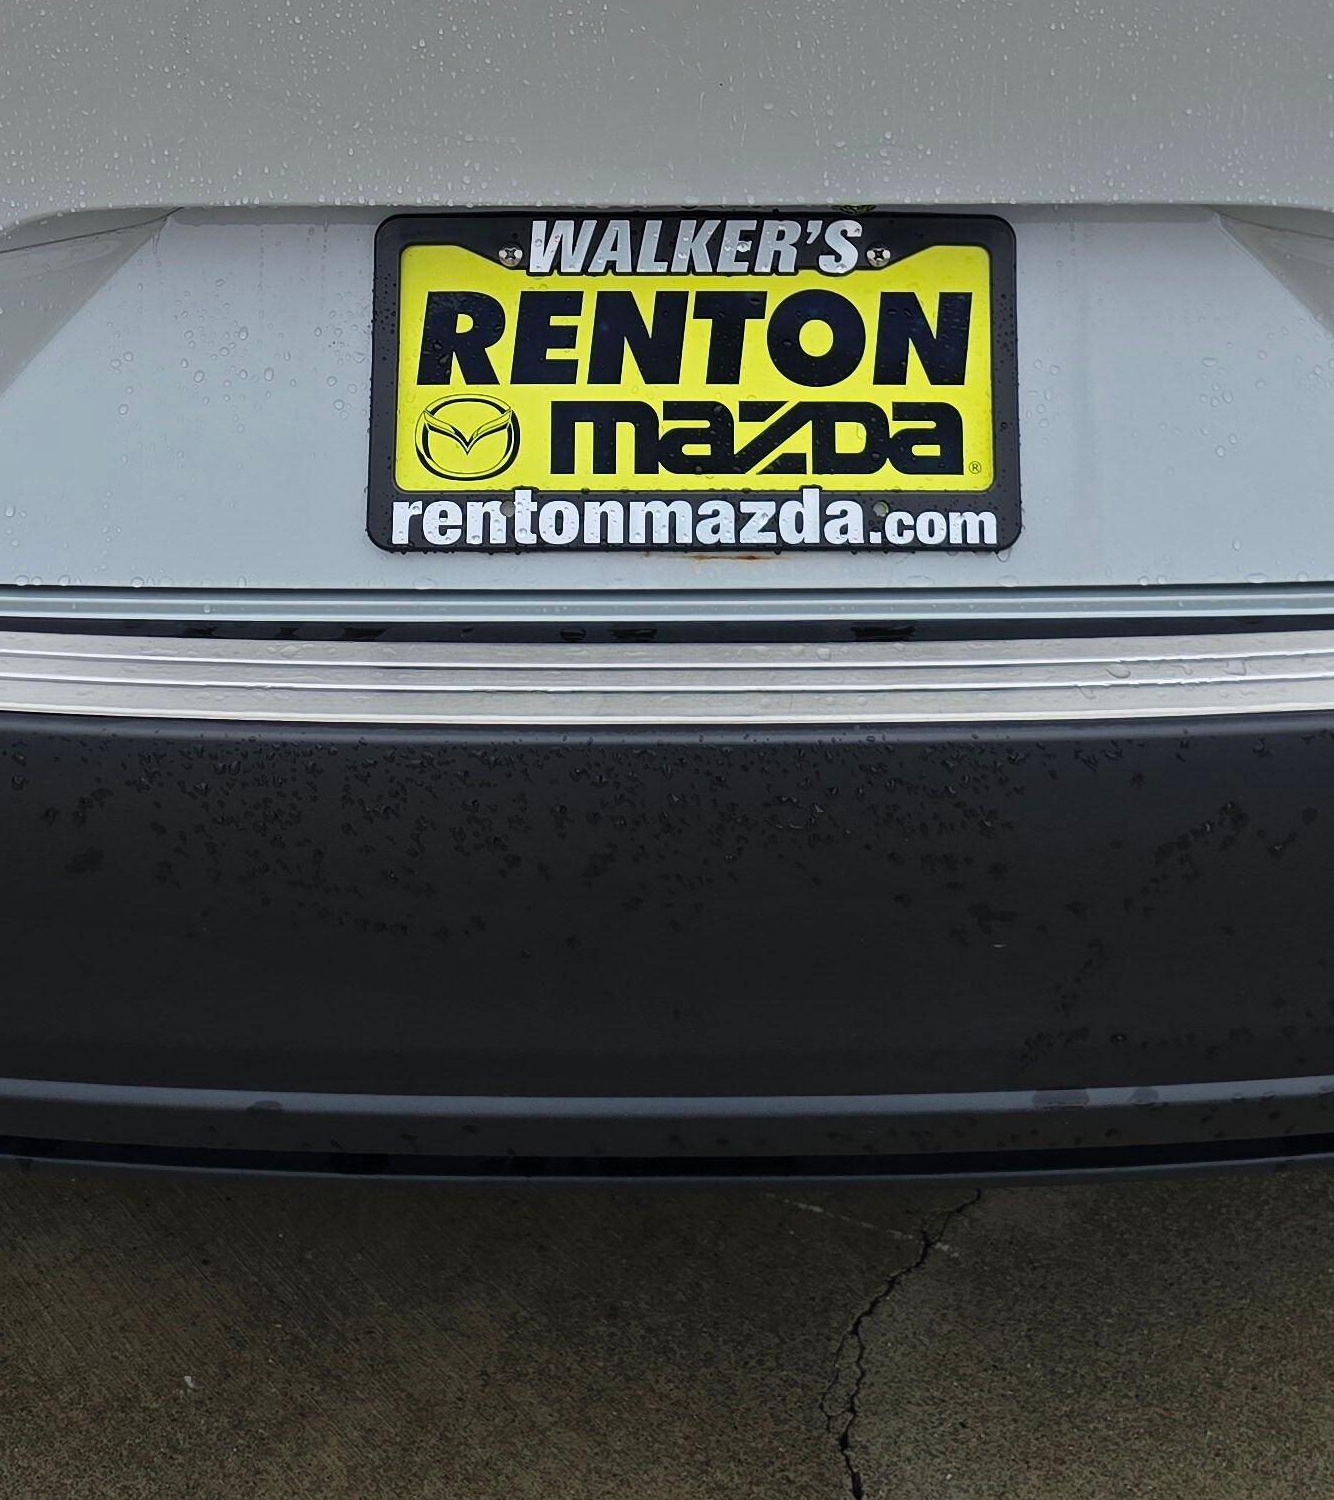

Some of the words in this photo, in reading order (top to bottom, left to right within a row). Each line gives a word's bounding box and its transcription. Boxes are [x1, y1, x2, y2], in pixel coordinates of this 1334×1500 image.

[528, 220, 862, 274] WALKER'S
[416, 289, 973, 387] RENTON
[550, 401, 965, 475] mazda
[392, 488, 998, 546] rentonmazda.com
